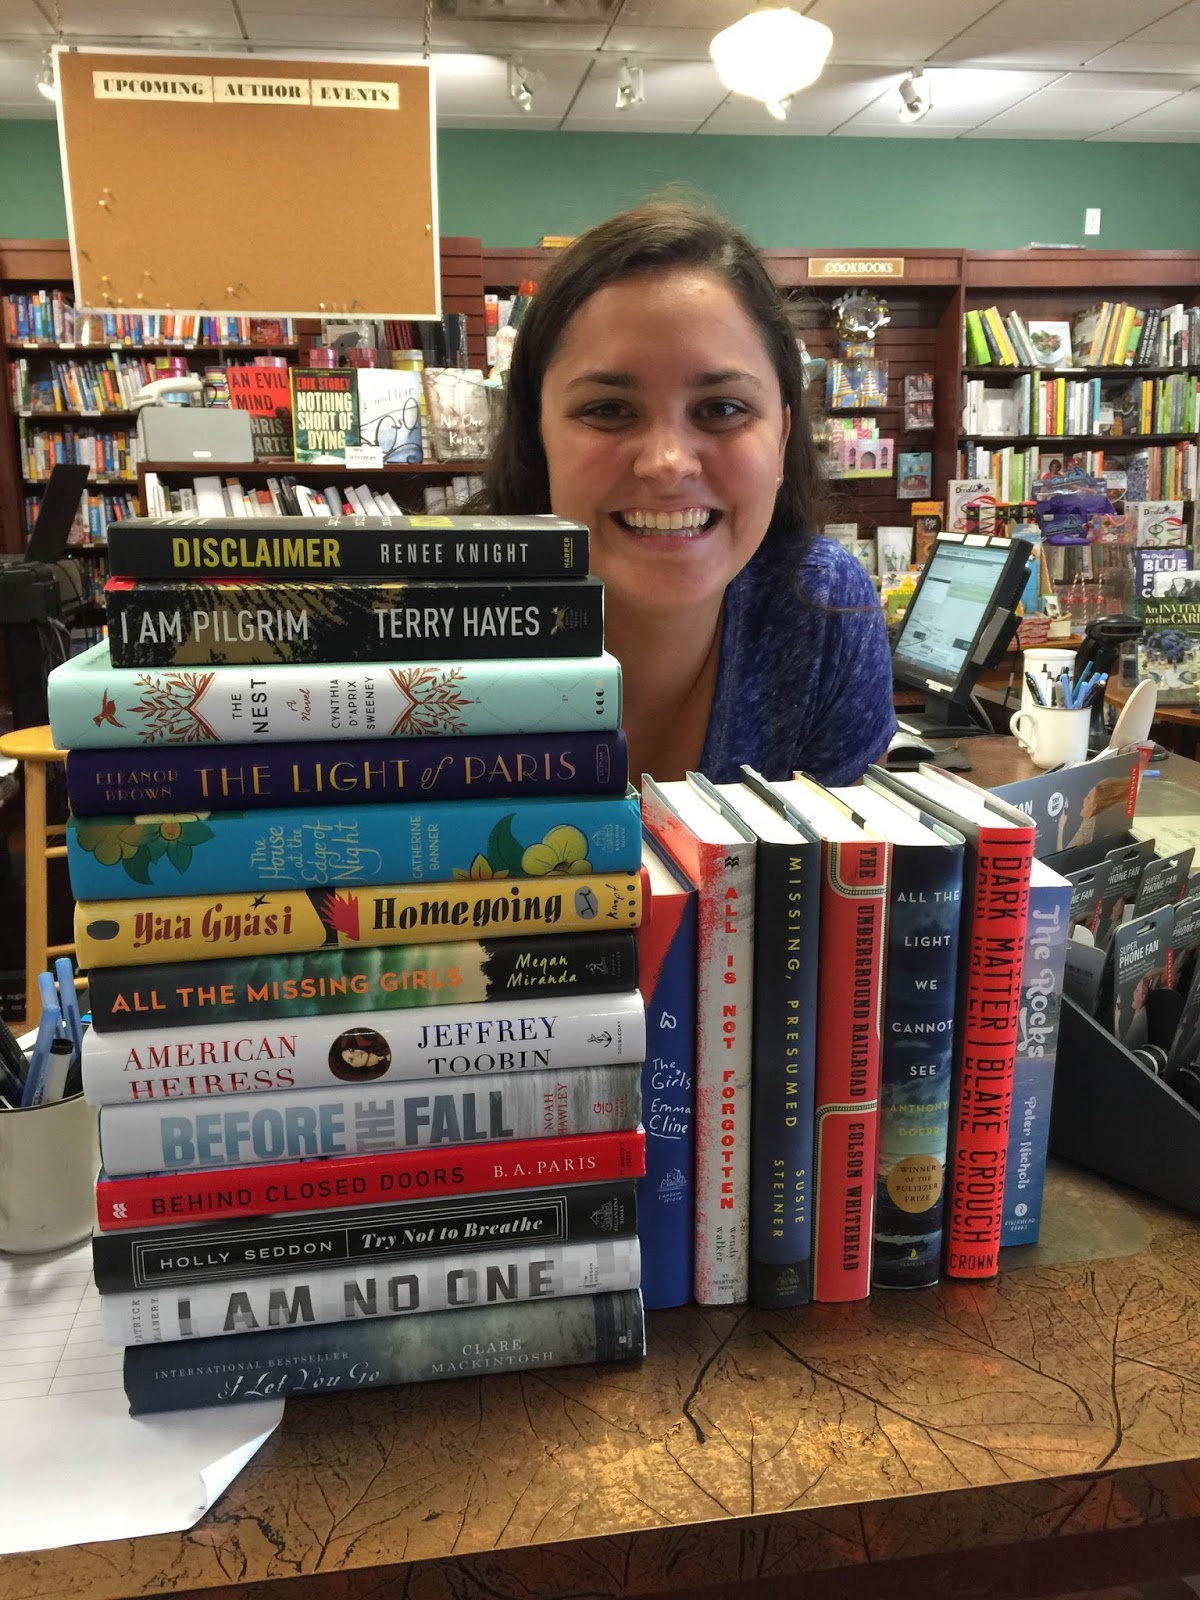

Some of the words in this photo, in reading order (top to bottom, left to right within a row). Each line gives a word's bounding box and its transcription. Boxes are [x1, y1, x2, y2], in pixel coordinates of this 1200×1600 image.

[103, 78, 205, 97] UPCOMING
[224, 82, 302, 99] AUTHOR
[320, 86, 391, 103] EVENTS
[825, 261, 894, 274] COOKBOOKS
[232, 372, 251, 389] AN
[255, 372, 287, 389] EVIL
[296, 377, 316, 390] ERIK
[318, 377, 351, 391] STOREY
[235, 394, 273, 410] MIND
[297, 391, 352, 412] NOTHING
[250, 418, 284, 434] HRIS
[298, 412, 336, 430] SHORT
[339, 412, 353, 430] OF
[440, 413, 458, 428] No
[462, 413, 483, 427] One
[307, 430, 346, 450] DYING
[172, 537, 341, 568] DISCLAIMER
[380, 543, 443, 564] RENEE
[455, 543, 529, 564] KNIGHT
[1143, 559, 1188, 572] BLUE
[374, 607, 454, 639] TERRY
[462, 605, 540, 638] HAYES
[1145, 605, 1158, 614] An
[1145, 616, 1154, 624] to
[1155, 614, 1171, 624] the
[120, 611, 129, 644] I
[139, 611, 183, 644] AM
[192, 609, 309, 643] PILGRIM
[231, 693, 243, 720] THE
[250, 678, 270, 734] NEST
[287, 699, 299, 712] A
[299, 687, 311, 722] Novel
[329, 678, 341, 729] CYNTHIA
[348, 680, 359, 727] D'APRIX
[364, 675, 376, 730] SWEENEY
[96, 770, 178, 786] ELEANOR
[193, 765, 271, 797] THE
[292, 759, 410, 793] LIGHT
[420, 756, 454, 790] of
[465, 751, 576, 785] PARIS
[105, 787, 172, 801] BROWN
[286, 828, 303, 850] the
[302, 819, 333, 840] of
[251, 836, 267, 868] The
[257, 825, 297, 884] House
[287, 854, 303, 869] at
[329, 818, 382, 882] Night
[410, 815, 423, 879] CATHERINE
[428, 823, 440, 872] BANNER
[301, 842, 341, 884] Edge
[859, 847, 878, 879] THE
[1127, 866, 1141, 878] FAN
[897, 891, 927, 903] ALL
[934, 889, 960, 902] THE
[988, 856, 1022, 920] DARK
[1080, 888, 1095, 902] FAN
[1142, 880, 1164, 896] PHONE
[1164, 874, 1178, 887] FAN
[372, 886, 562, 930] Homegoing
[605, 883, 625, 920] Knopf
[724, 886, 739, 934] ALL
[133, 911, 192, 949] Yaa
[201, 903, 293, 943] Gyasi
[785, 857, 802, 980] MISSING,
[1030, 904, 1061, 961] The
[1172, 923, 1195, 938] PHONE
[904, 935, 951, 947] LIGHT
[1119, 940, 1138, 957] SUPER
[1119, 949, 1144, 969] PHONE
[1145, 939, 1159, 956] FAN
[515, 953, 568, 973] Megan
[723, 955, 737, 985] IS
[852, 904, 875, 1020] UNDERGROUND
[111, 990, 167, 1013] ALL
[176, 984, 236, 1008] THE
[247, 974, 369, 1003] MISSING
[380, 966, 463, 993] GIRLS
[506, 969, 578, 989] Miranda
[914, 979, 938, 990] WE
[980, 937, 1016, 1030] MATTER
[722, 1005, 737, 1049] NOT
[891, 1019, 953, 1034] CANNOT
[1017, 968, 1056, 1060] Rocks
[417, 1015, 559, 1050] JEFFREY
[123, 1035, 298, 1072] AMERICAN
[428, 1049, 551, 1076] TOOBIN
[652, 1057, 676, 1070] The
[785, 1000, 799, 1128] PRESUMED
[850, 1022, 870, 1097] RAILROAD
[128, 1068, 296, 1101] HEIRESS
[651, 1069, 692, 1090] Girls
[909, 1065, 936, 1076] SEE
[543, 1092, 554, 1131] NOAH
[557, 1082, 569, 1135] HAWLEY
[650, 1098, 692, 1114] Emma
[889, 1102, 949, 1114] ANTHONY
[971, 1058, 1006, 1134] BLAKE
[160, 1102, 347, 1168] BEFORE
[354, 1099, 396, 1151] THE
[403, 1090, 514, 1147] FALL
[649, 1115, 689, 1134] Cline
[899, 1126, 940, 1137] DOERR
[1023, 1096, 1037, 1137] Peter
[720, 1070, 736, 1210] FORGOTTEN
[847, 1122, 865, 1179] COLSON
[493, 1164, 508, 1179] B.
[513, 1163, 531, 1176] A.
[537, 1156, 597, 1174] PARIS
[900, 1164, 937, 1173] WINNER
[1017, 1140, 1033, 1190] Nichols
[151, 1188, 252, 1216] BEHIND
[265, 1176, 367, 1203] CLOSED
[380, 1167, 465, 1191] DOORS
[772, 1159, 785, 1237] STEINER
[794, 1169, 805, 1224] SUSIE
[895, 1183, 938, 1193] PULITZER
[904, 1195, 930, 1203] PRIZE
[963, 1150, 998, 1244] CROUCH
[361, 1231, 398, 1250] Try
[401, 1228, 433, 1245] Not
[439, 1225, 459, 1241] to
[463, 1217, 543, 1239] Breathe
[716, 1226, 726, 1262] walker
[726, 1226, 739, 1258] wendy
[843, 1185, 862, 1272] WHITEHEAD
[160, 1252, 230, 1270] HOLLY
[244, 1241, 333, 1261] SEDDON
[950, 1253, 994, 1271] CROWN
[177, 1297, 193, 1336] I
[223, 1285, 315, 1332] AM
[344, 1274, 420, 1318] NO
[446, 1260, 555, 1306] ONE
[132, 1298, 143, 1343] PATRICK
[431, 1351, 554, 1374] MACKINTOSH
[462, 1338, 523, 1356] CLARE
[155, 1360, 262, 1380] INTERNATIONAL
[268, 1350, 349, 1368] BESTSELLER
[217, 1375, 244, 1400] I
[244, 1370, 286, 1397] Let
[293, 1367, 342, 1392] You
[349, 1361, 381, 1384] Go
